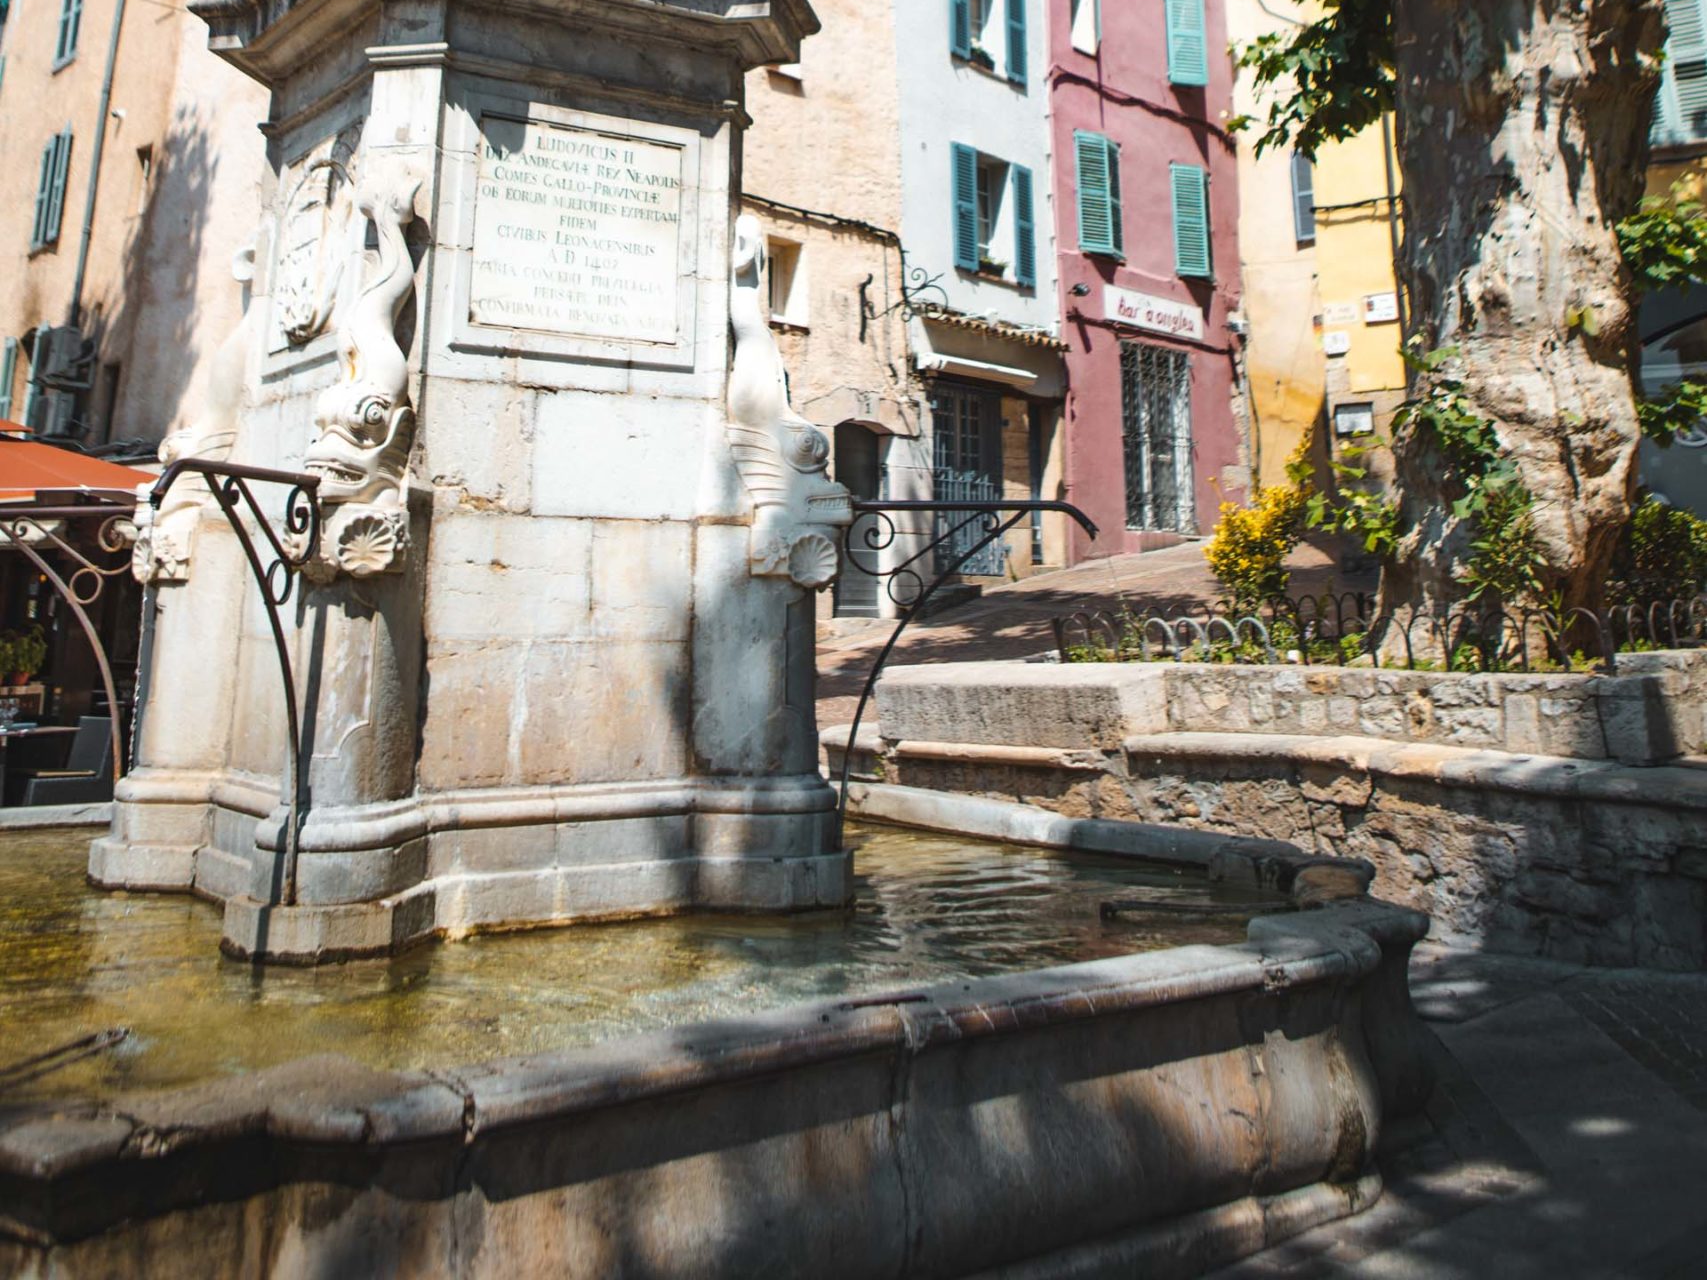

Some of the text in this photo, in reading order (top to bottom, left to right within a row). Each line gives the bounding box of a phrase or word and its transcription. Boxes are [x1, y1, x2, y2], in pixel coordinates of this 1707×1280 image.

[536, 135, 616, 160] LUDOVICUS
[626, 168, 679, 189] NEAPOLIS
[559, 214, 596, 231] FIDEM
